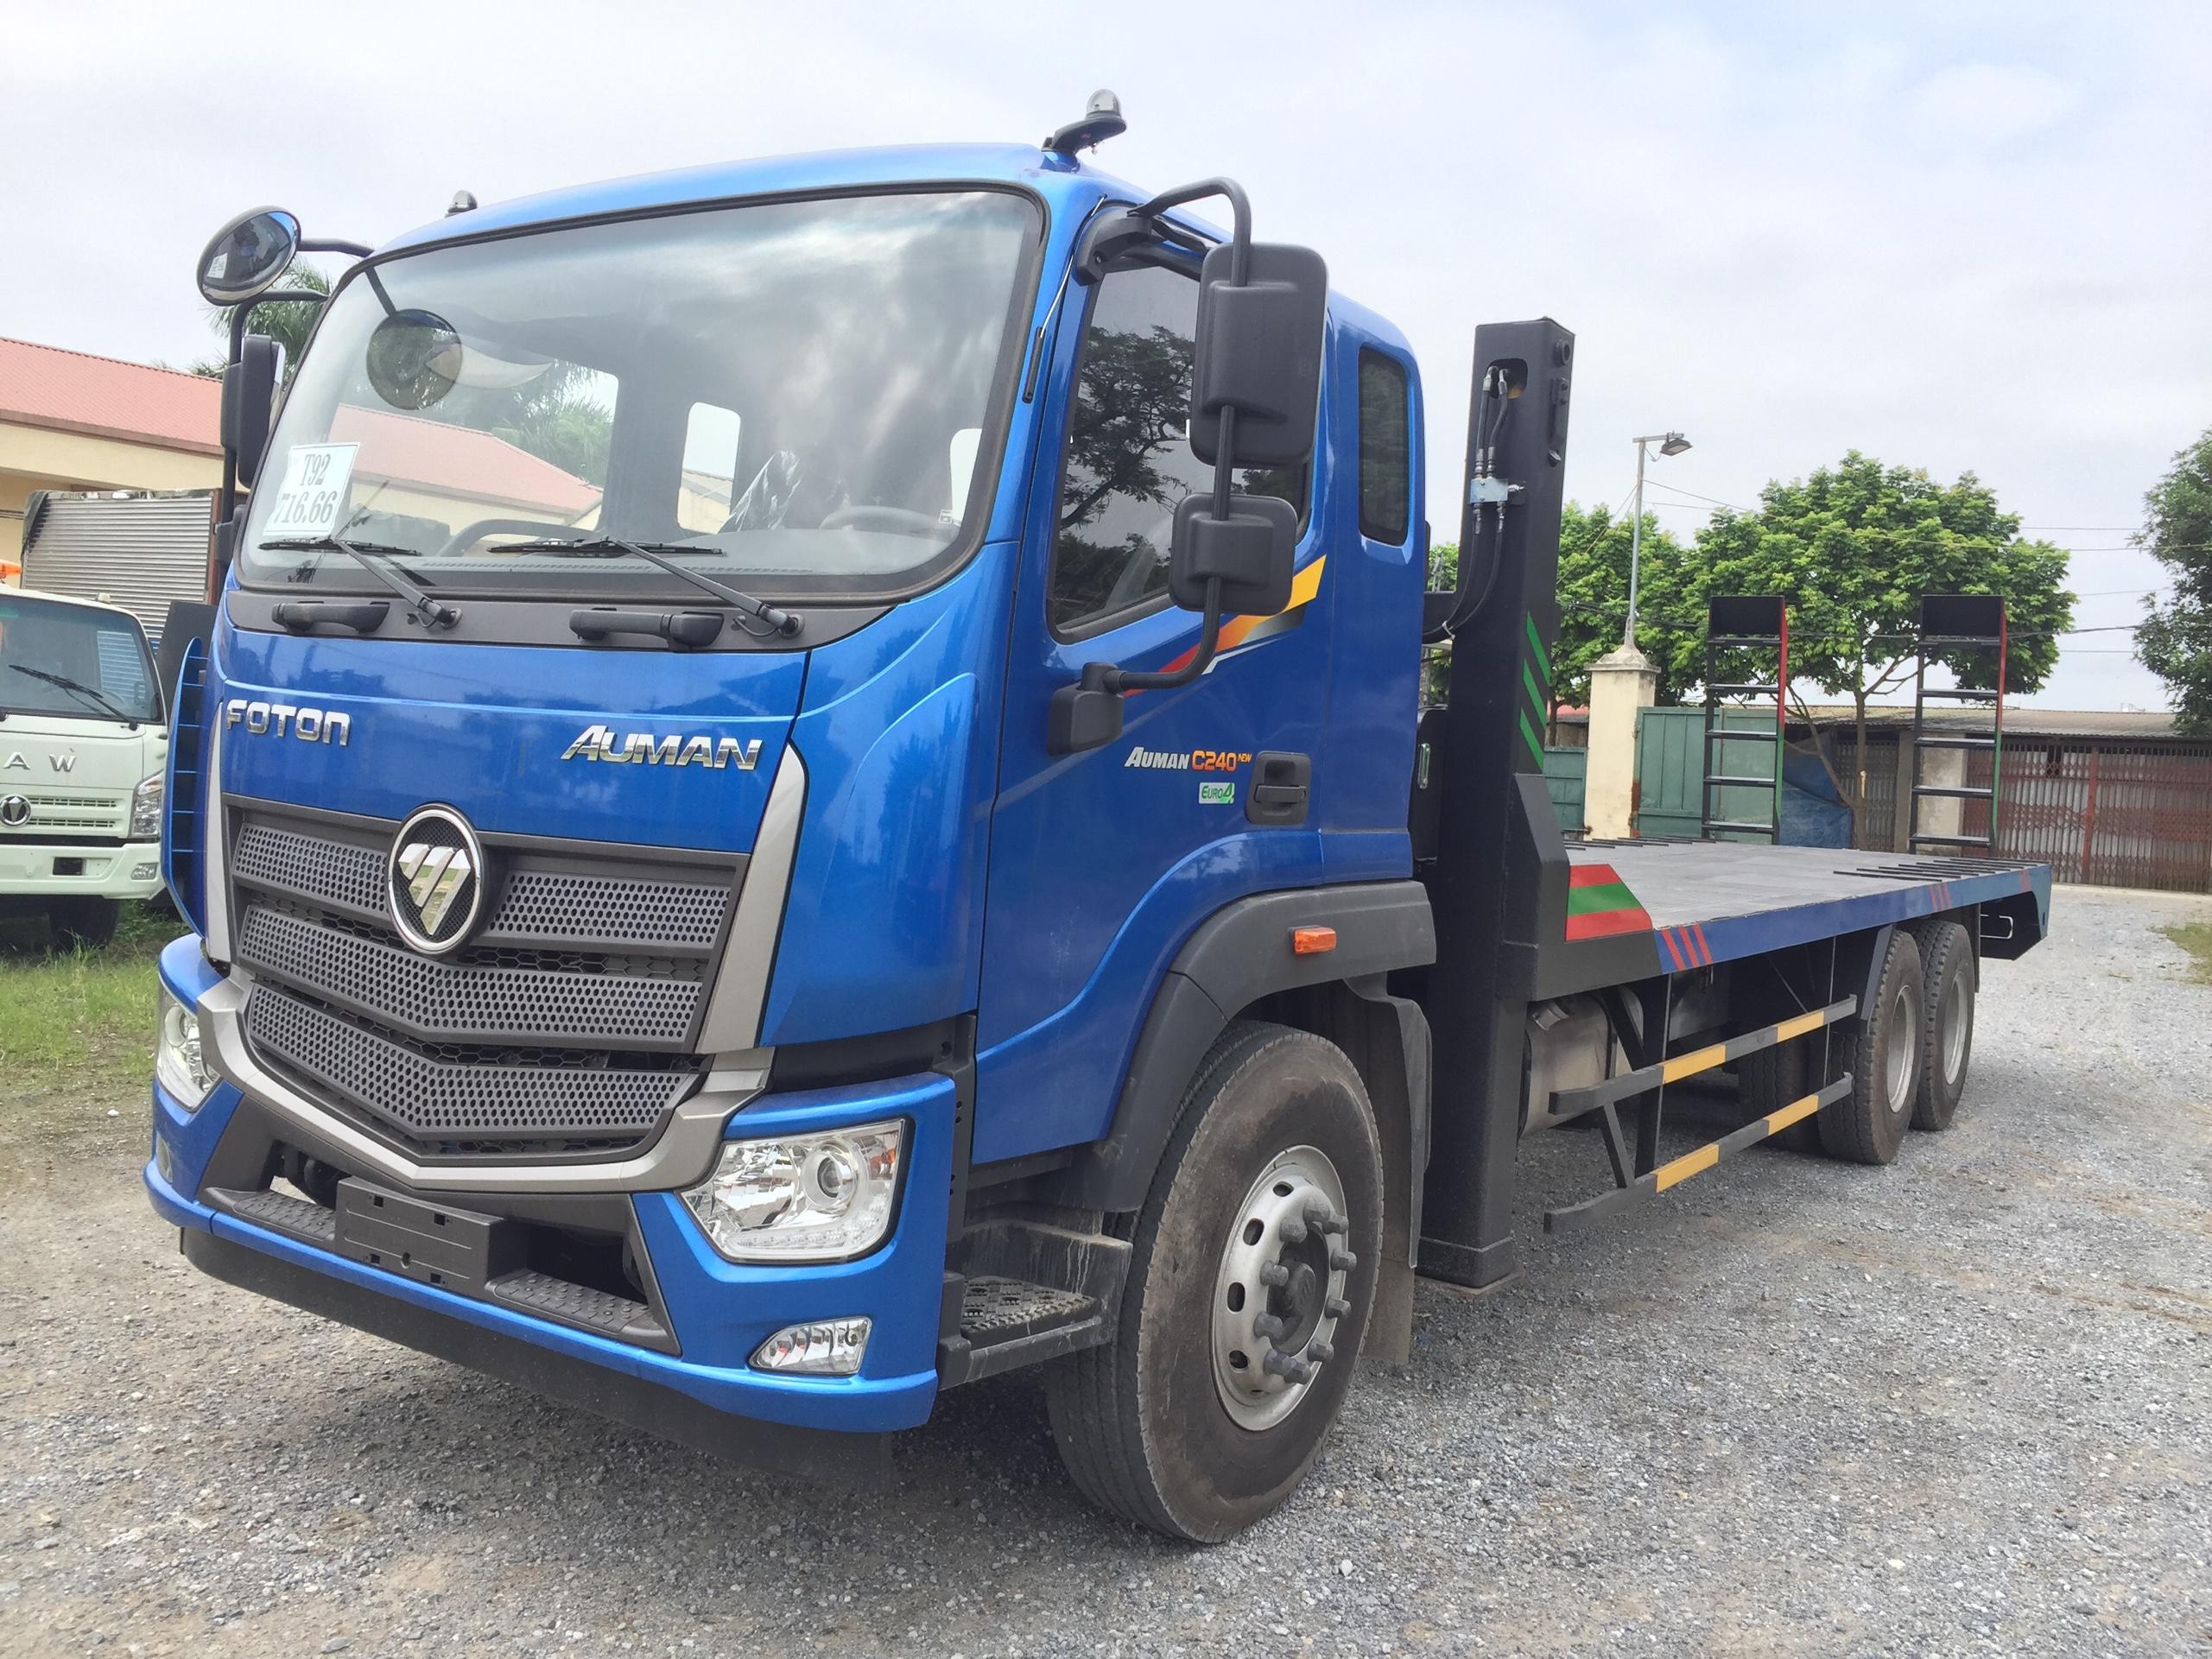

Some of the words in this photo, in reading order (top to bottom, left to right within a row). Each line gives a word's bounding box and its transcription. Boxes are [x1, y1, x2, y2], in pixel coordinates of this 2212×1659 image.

[299, 453, 331, 486] T92
[274, 491, 338, 523] 716.66
[227, 699, 351, 746] FOTON
[561, 725, 763, 770] AUMAN
[1125, 746, 1190, 770] AUMAN
[1192, 750, 1237, 772] C240
